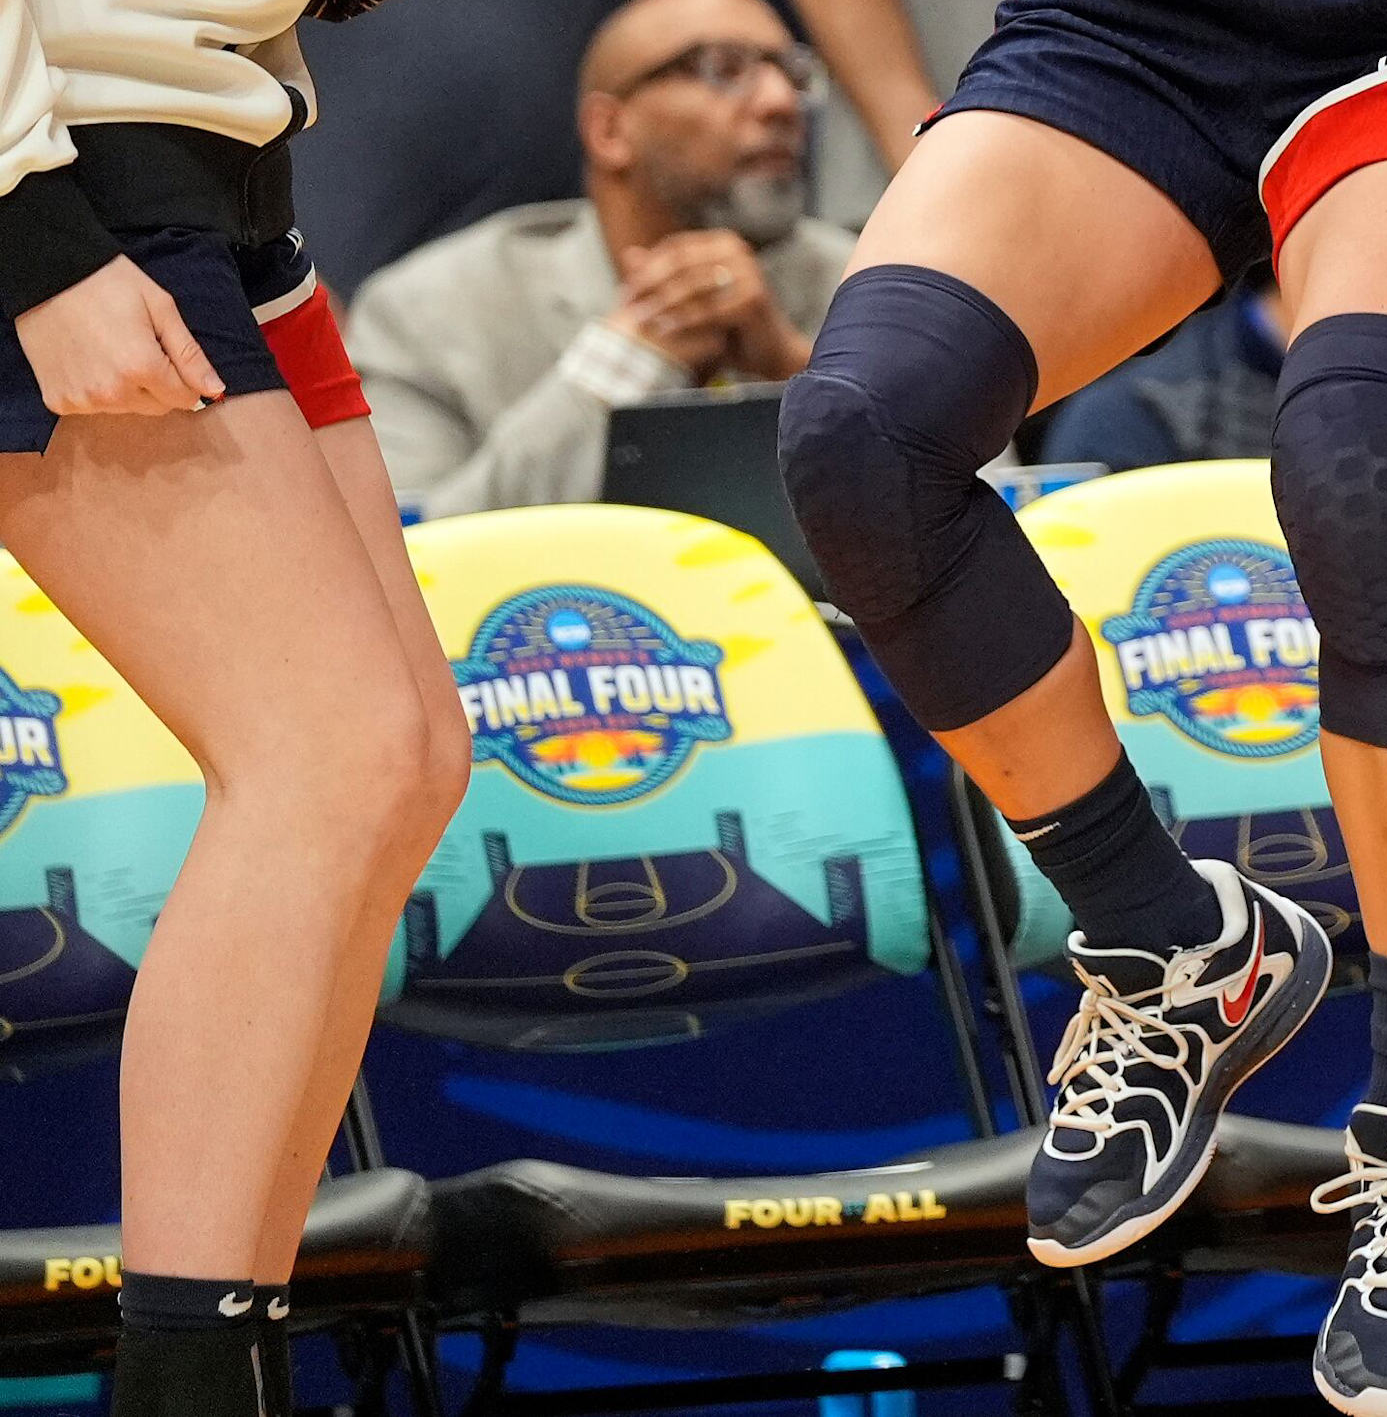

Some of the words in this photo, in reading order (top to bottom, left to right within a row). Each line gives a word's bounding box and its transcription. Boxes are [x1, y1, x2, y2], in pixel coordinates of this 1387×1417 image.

[1117, 623, 1246, 690] FINAL
[459, 669, 585, 734] FINAL
[586, 665, 721, 714] FOUR
[724, 1196, 844, 1230] FOUR
[862, 1189, 948, 1224] ALL
[44, 1255, 122, 1291] FOU
